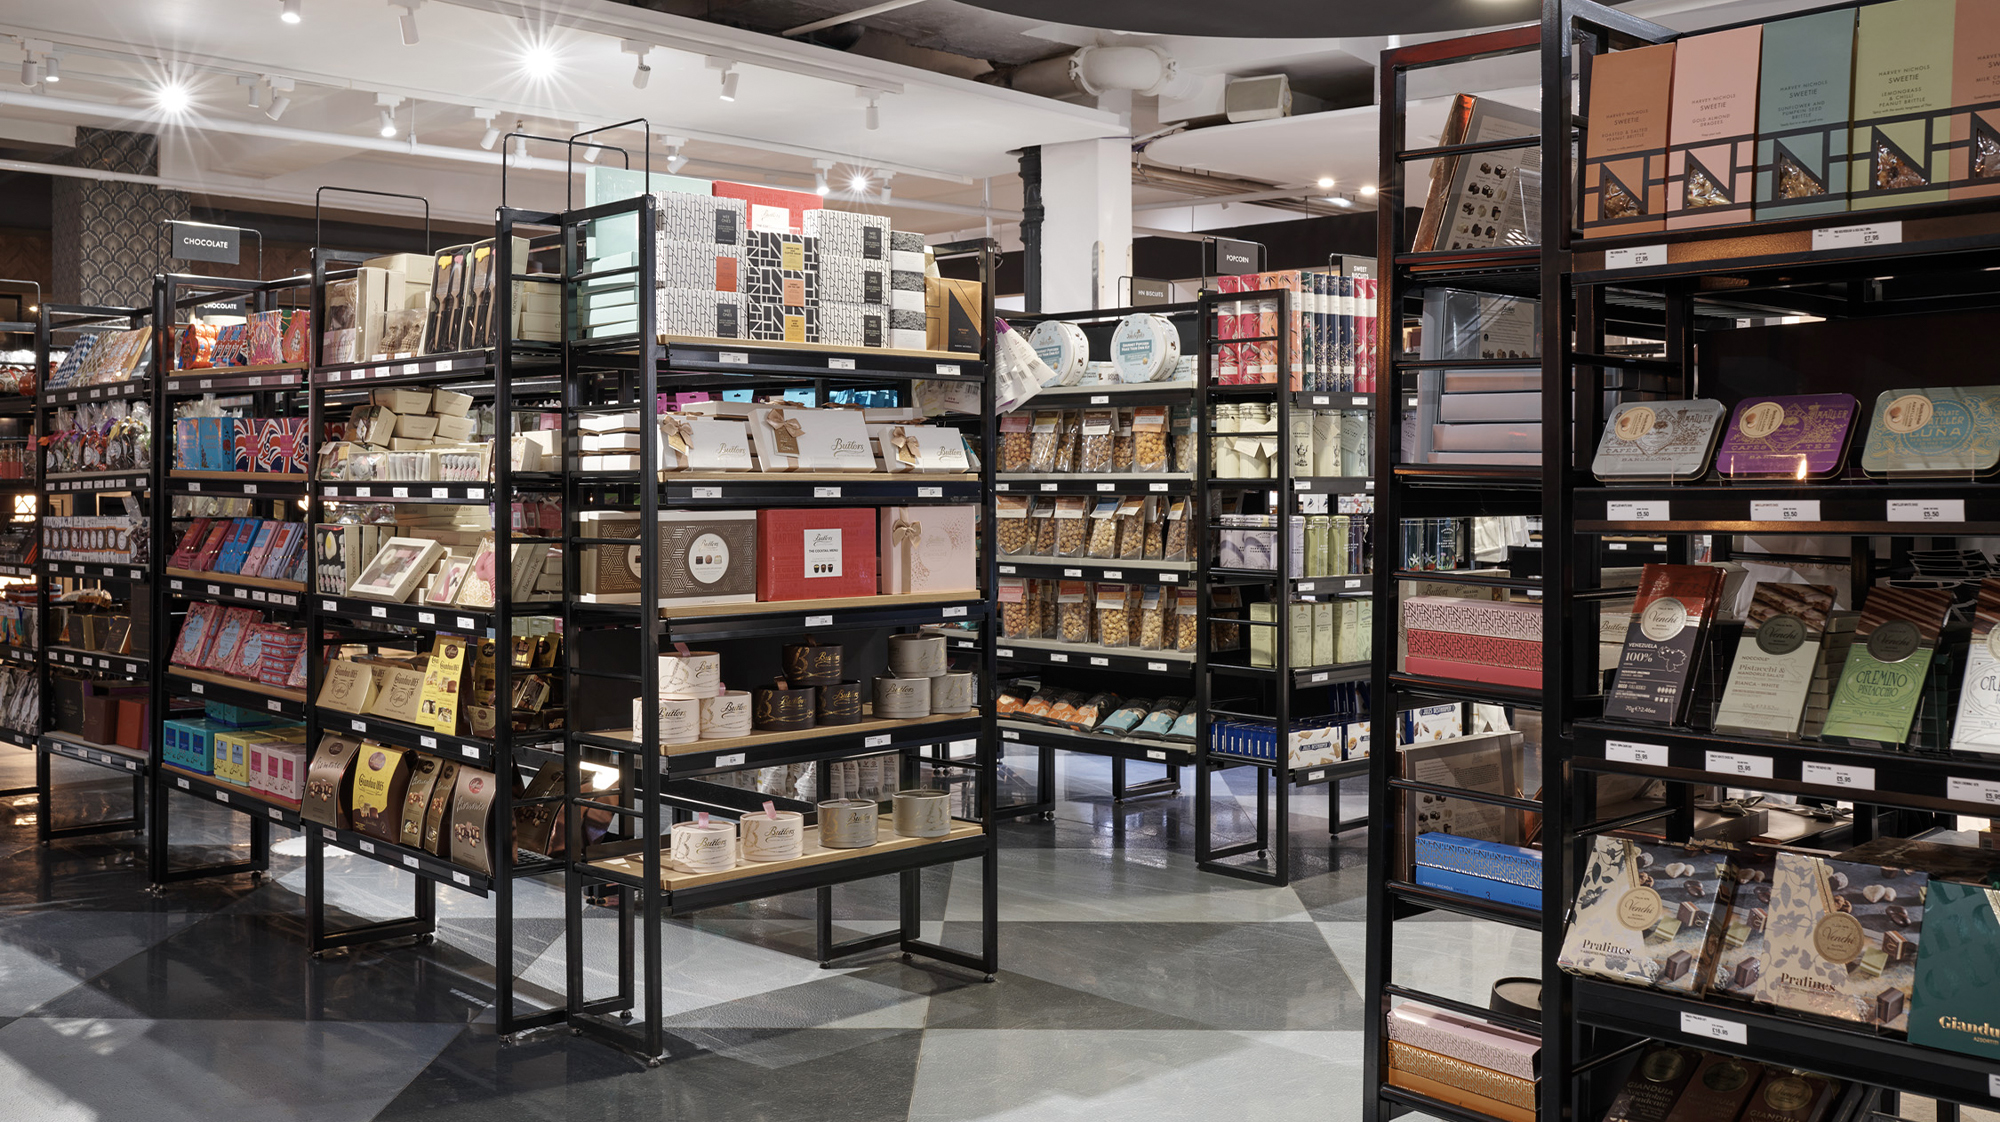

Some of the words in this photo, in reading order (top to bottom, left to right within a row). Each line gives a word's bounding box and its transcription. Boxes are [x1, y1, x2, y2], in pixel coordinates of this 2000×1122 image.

[1903, 65, 1930, 73] NICHOLS
[1802, 80, 1828, 88] NICHOLS
[1888, 73, 1919, 84] SWEETIE
[1789, 88, 1818, 99] SWEETIE
[1881, 87, 1922, 97] LEMONGRASS
[1895, 93, 1914, 101] CHILLI
[1691, 97, 1711, 105] HARVEY
[1713, 93, 1736, 102] NICHOLS
[1904, 97, 1926, 105] BRITTLE
[1700, 101, 1727, 111] SWEETIE
[1778, 102, 1811, 112] SUNFLOWER
[1626, 109, 1649, 117] NICHOLS
[1707, 113, 1731, 121] ALMOND
[1791, 112, 1812, 120] BRITTLE
[1614, 117, 1640, 126] SWEETIE
[1601, 130, 1620, 138] ROASTED
[1606, 134, 1625, 142] PEANUT
[184, 237, 228, 249] CHOCOLATE
[1864, 234, 1880, 242] £7.95
[1226, 254, 1249, 264] POPCORN
[1635, 255, 1648, 263] £7.95
[1146, 290, 1164, 298] BISCUITS
[1909, 427, 1962, 438] LUNA
[716, 443, 747, 456] Butlers
[831, 437, 865, 452] Butlers
[937, 445, 963, 457] Butlers
[1421, 583, 1448, 596] Butlers
[1649, 610, 1679, 624] Venchi
[1601, 620, 1629, 631] Butlers
[1764, 627, 1798, 640] Venchi
[1875, 632, 1912, 646] Venchi
[814, 651, 840, 664] Butlers
[1625, 652, 1653, 663] 100%
[350, 668, 358, 678] 1865
[1739, 663, 1777, 673] Pistacchi
[412, 676, 420, 687] 1865
[1856, 670, 1908, 688] CREMINO
[886, 683, 914, 693] Butlers
[1857, 684, 1899, 698] PISTACCHIO
[832, 689, 860, 700] Butlers
[721, 701, 748, 713] Butlers
[1625, 705, 1635, 713] 70g
[1837, 775, 1852, 783] £5.95
[847, 812, 873, 823] Butlers
[764, 825, 795, 838] Butlers
[697, 837, 727, 849] Butlers
[1625, 899, 1654, 914] Venchi
[1822, 926, 1855, 945] Venchi
[1582, 939, 1632, 955] Pralines
[1780, 972, 1836, 992] Pralines
[1627, 1081, 1674, 1097] GIANDUIA
